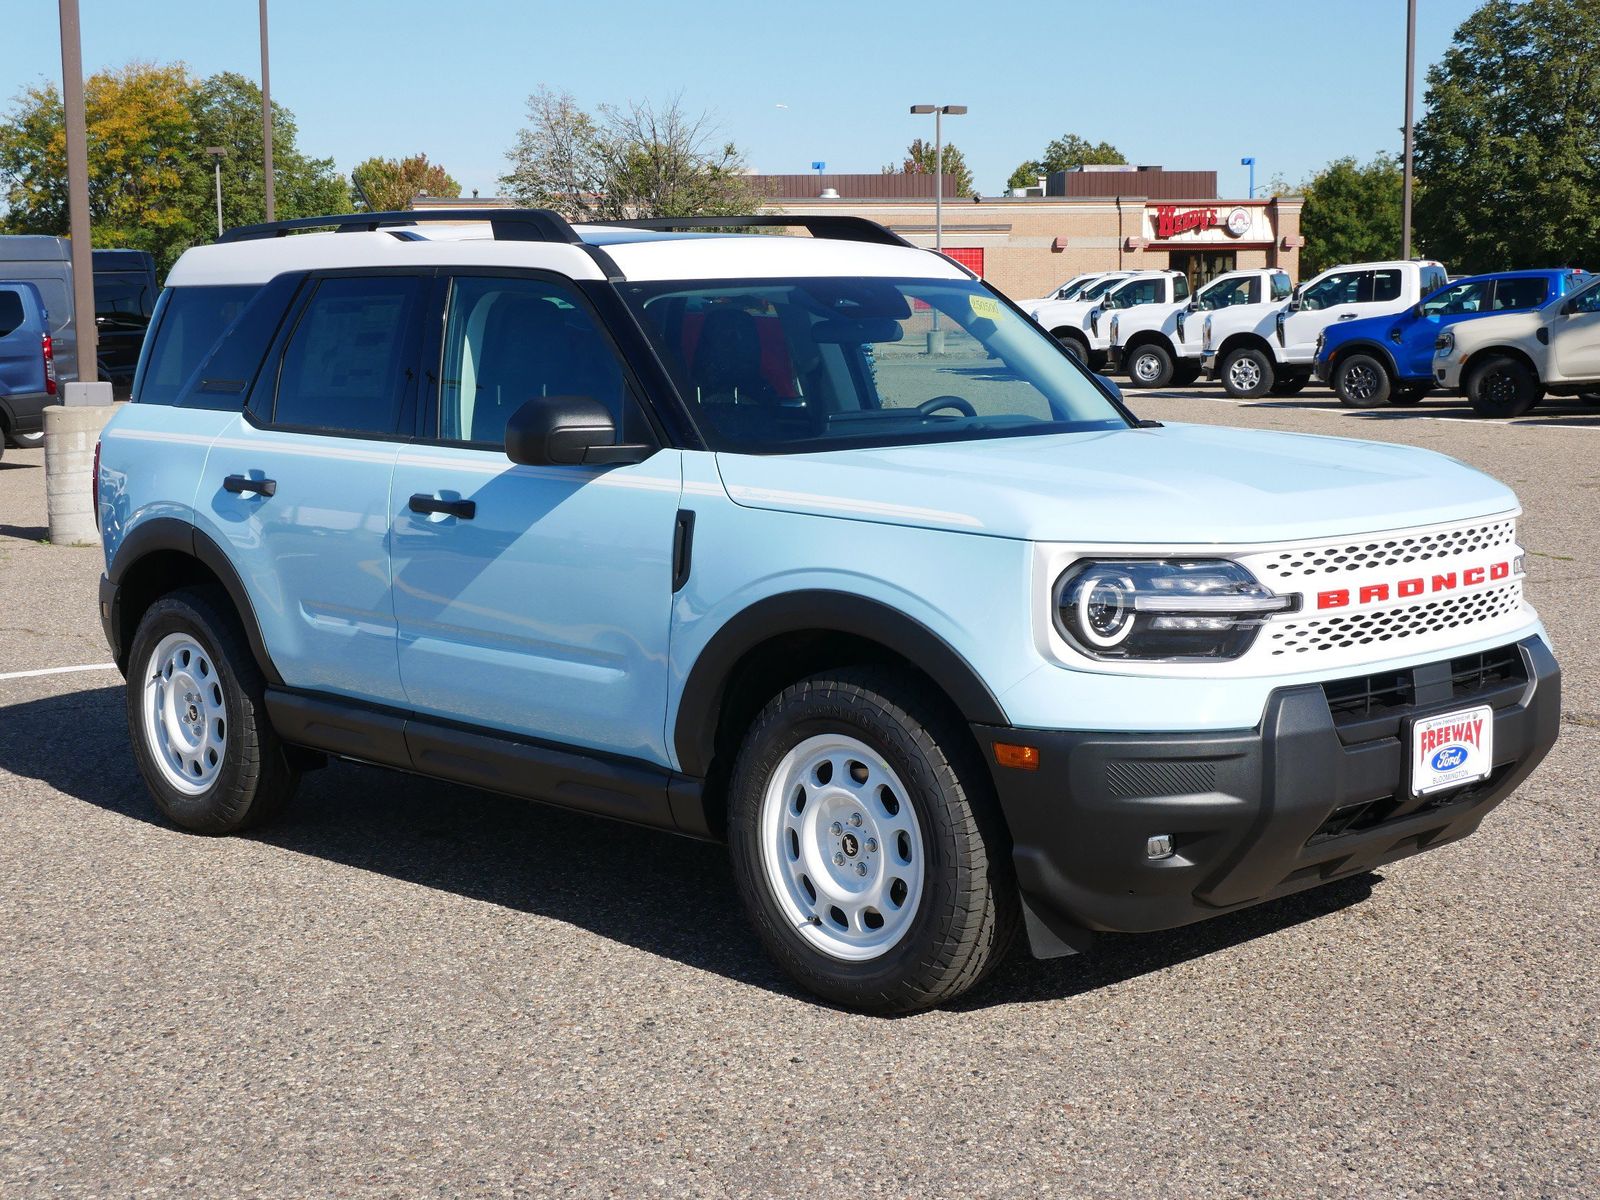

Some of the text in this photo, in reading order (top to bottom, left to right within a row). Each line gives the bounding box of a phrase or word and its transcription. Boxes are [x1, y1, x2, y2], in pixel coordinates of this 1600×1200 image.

[1317, 562, 1509, 609] BRONCO
[1421, 719, 1483, 767] FREEWAY
[1437, 749, 1461, 768] Ford
